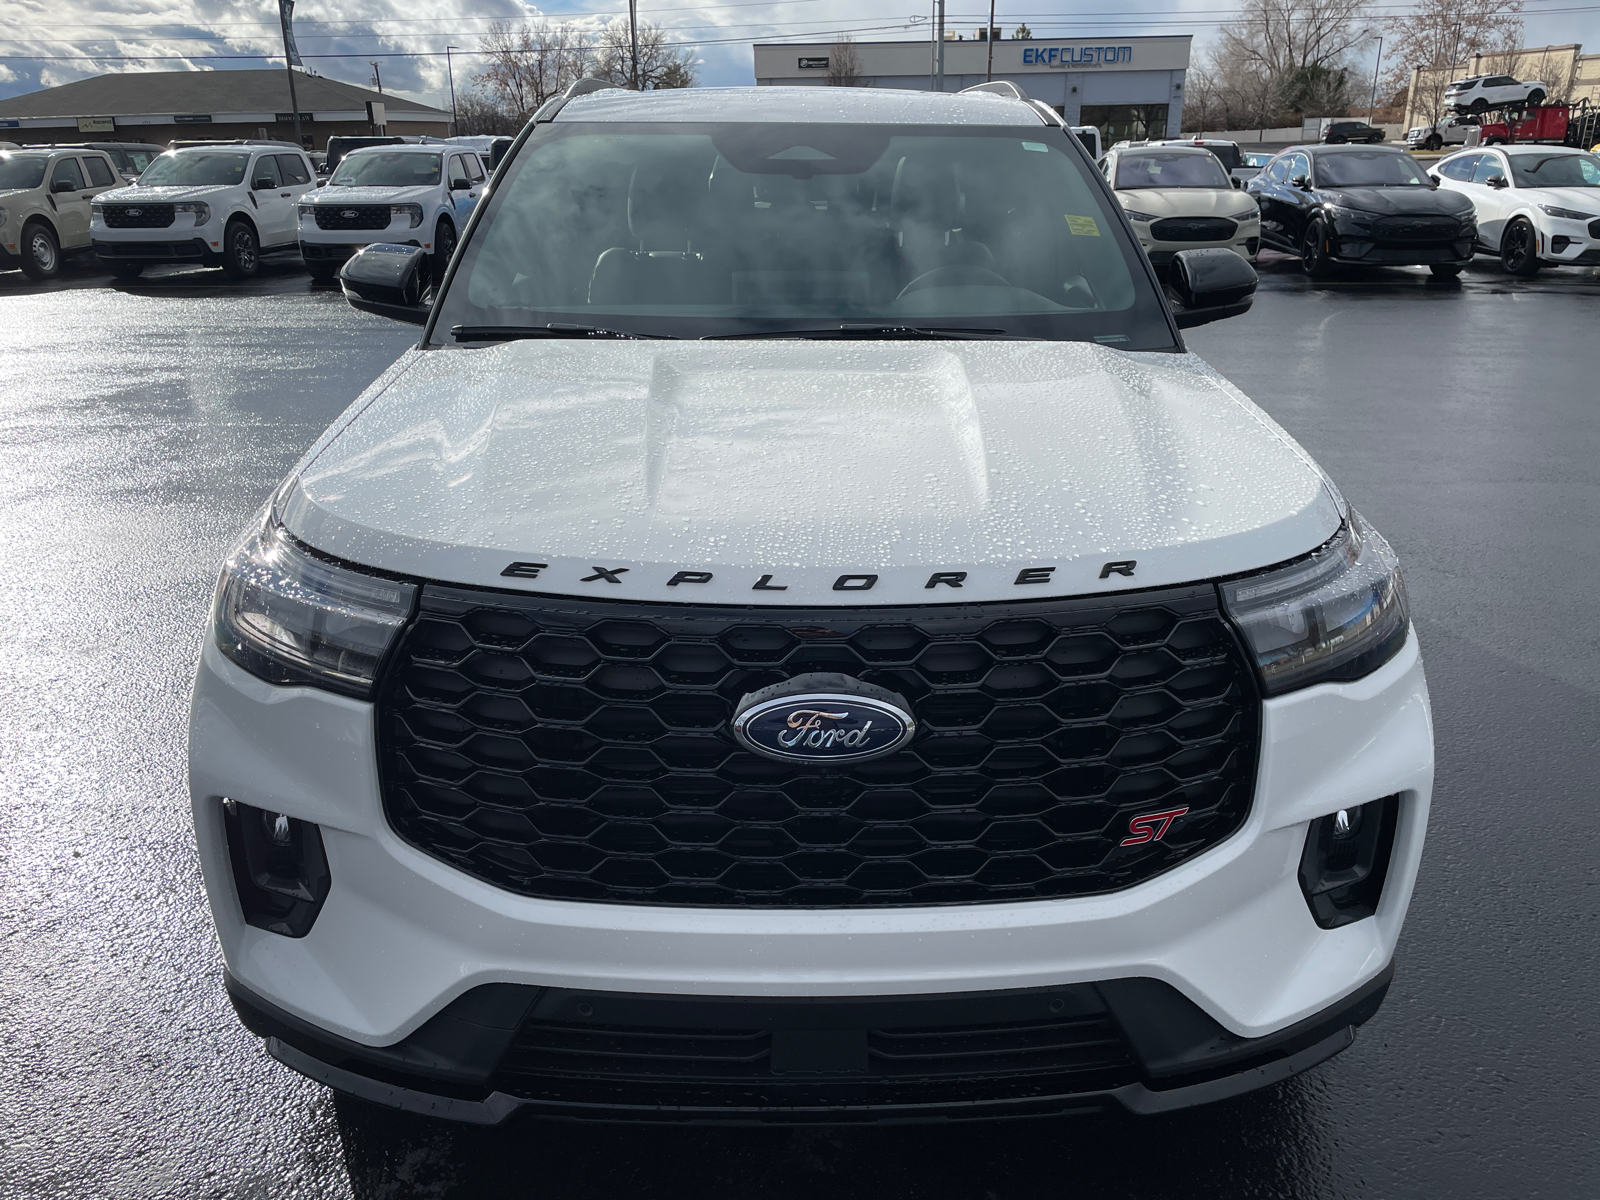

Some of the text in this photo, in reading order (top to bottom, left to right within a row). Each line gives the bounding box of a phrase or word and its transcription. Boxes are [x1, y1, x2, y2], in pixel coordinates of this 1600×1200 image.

[499, 559, 1138, 592] EXPLORER
[777, 709, 872, 748] Ford
[1120, 806, 1190, 847] ST
